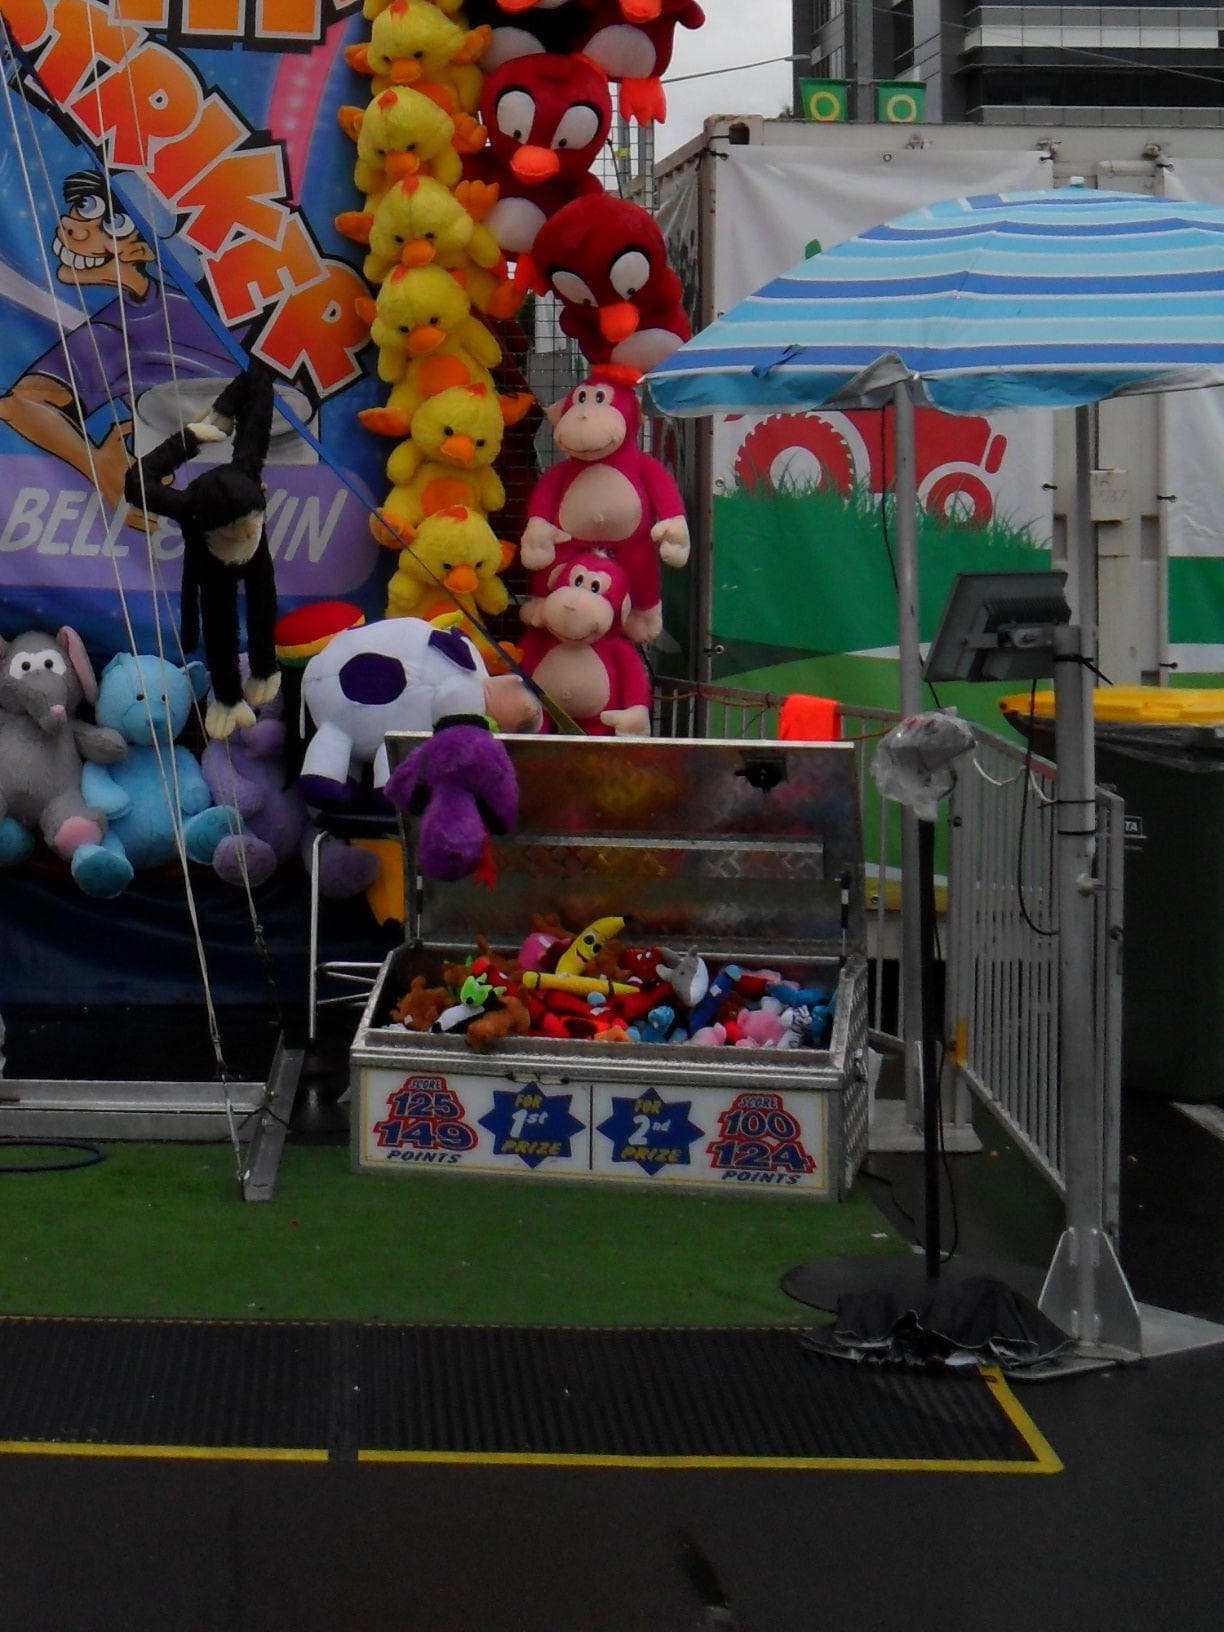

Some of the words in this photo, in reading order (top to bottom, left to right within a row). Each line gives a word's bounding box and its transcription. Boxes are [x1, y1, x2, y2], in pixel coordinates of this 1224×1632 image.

[410, 1079, 442, 1090] SCORE
[394, 1091, 460, 1119] 125
[515, 1094, 543, 1109] FOR
[634, 1098, 663, 1114] FOR
[738, 1096, 776, 1109] SCORE
[509, 1108, 549, 1139] 1st
[628, 1114, 672, 1146] 2nd
[723, 1110, 797, 1140] 100
[379, 1121, 473, 1151] 149
[501, 1140, 561, 1156] PRIZE
[621, 1146, 682, 1162] PRIZE
[387, 1150, 461, 1164] POINTS
[713, 1142, 808, 1172] 124
[721, 1170, 802, 1185] POINTS
